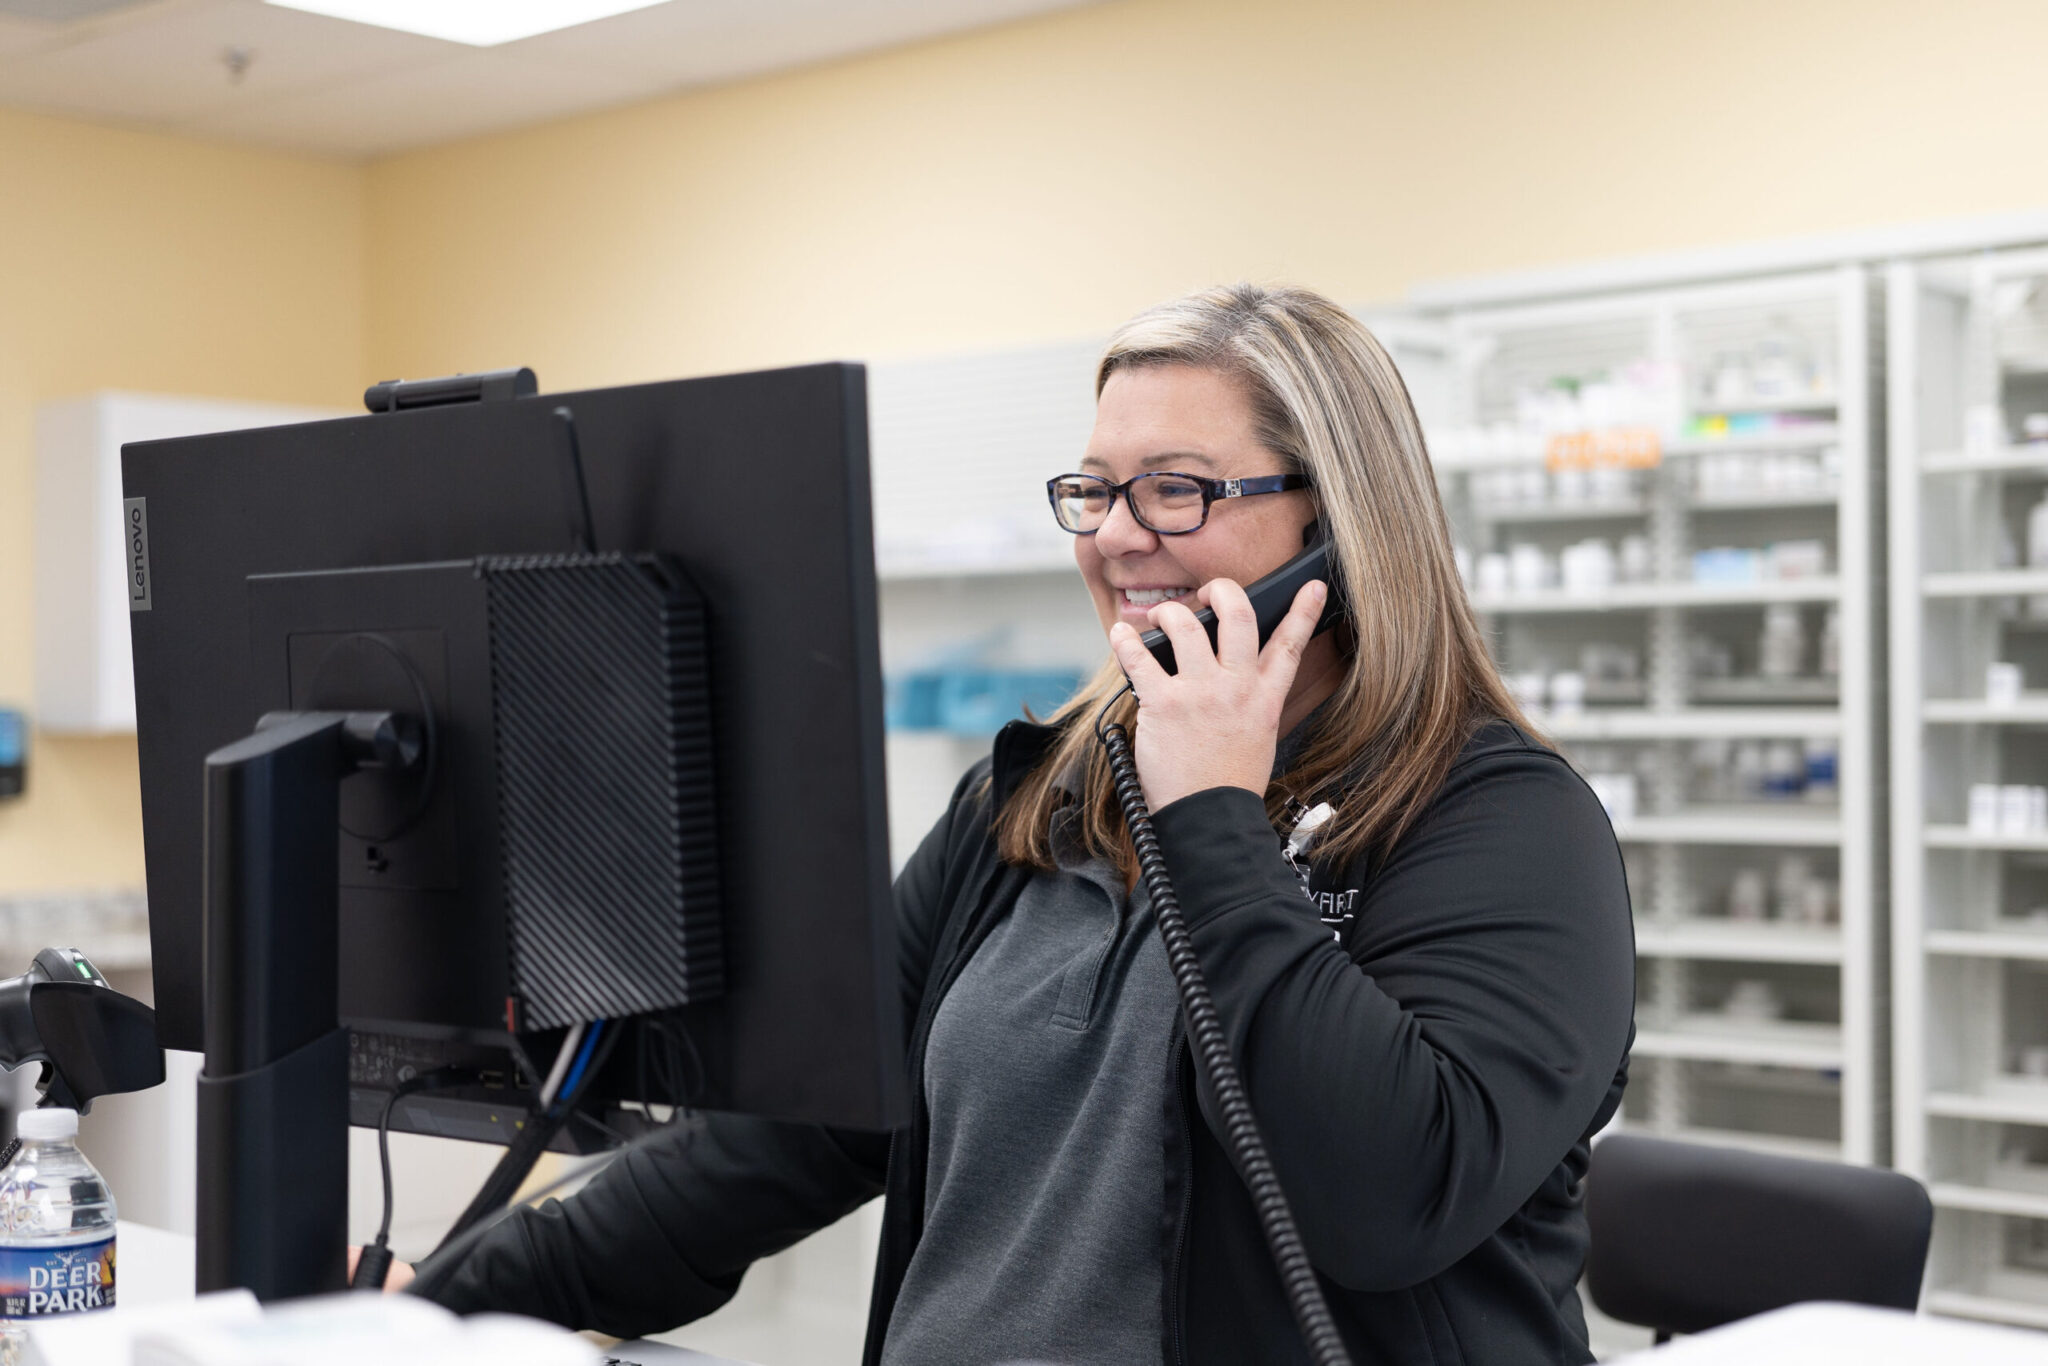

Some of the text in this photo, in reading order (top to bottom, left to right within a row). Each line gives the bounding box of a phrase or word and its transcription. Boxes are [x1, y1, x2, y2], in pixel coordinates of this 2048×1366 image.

[132, 507, 146, 600] Lenovo
[29, 1261, 102, 1289] DEER
[28, 1284, 103, 1314] PARK
